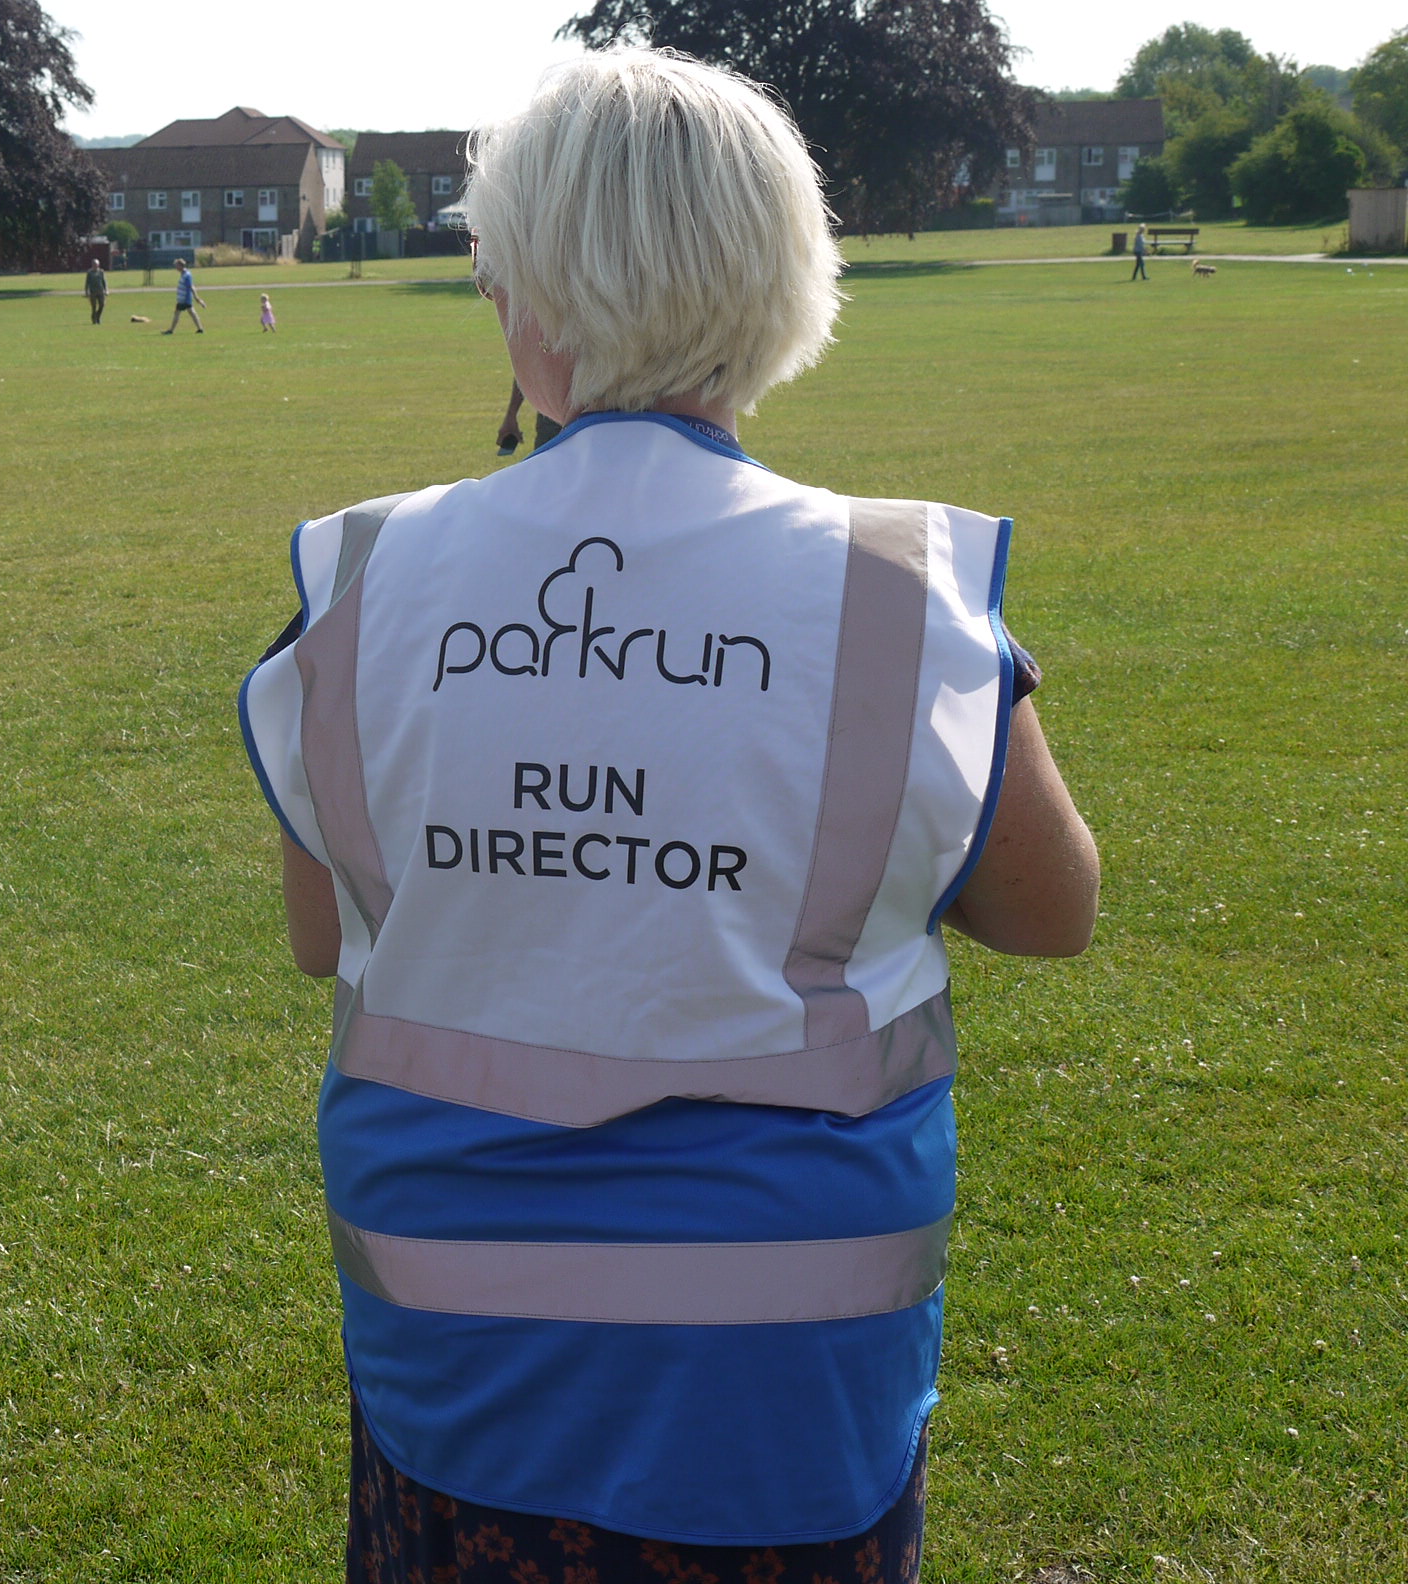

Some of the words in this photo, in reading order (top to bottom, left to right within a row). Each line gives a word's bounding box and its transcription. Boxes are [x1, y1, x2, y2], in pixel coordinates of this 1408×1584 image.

[433, 586, 770, 691] parkrun
[513, 762, 645, 816] RUN
[425, 824, 748, 892] DIRECTOR
